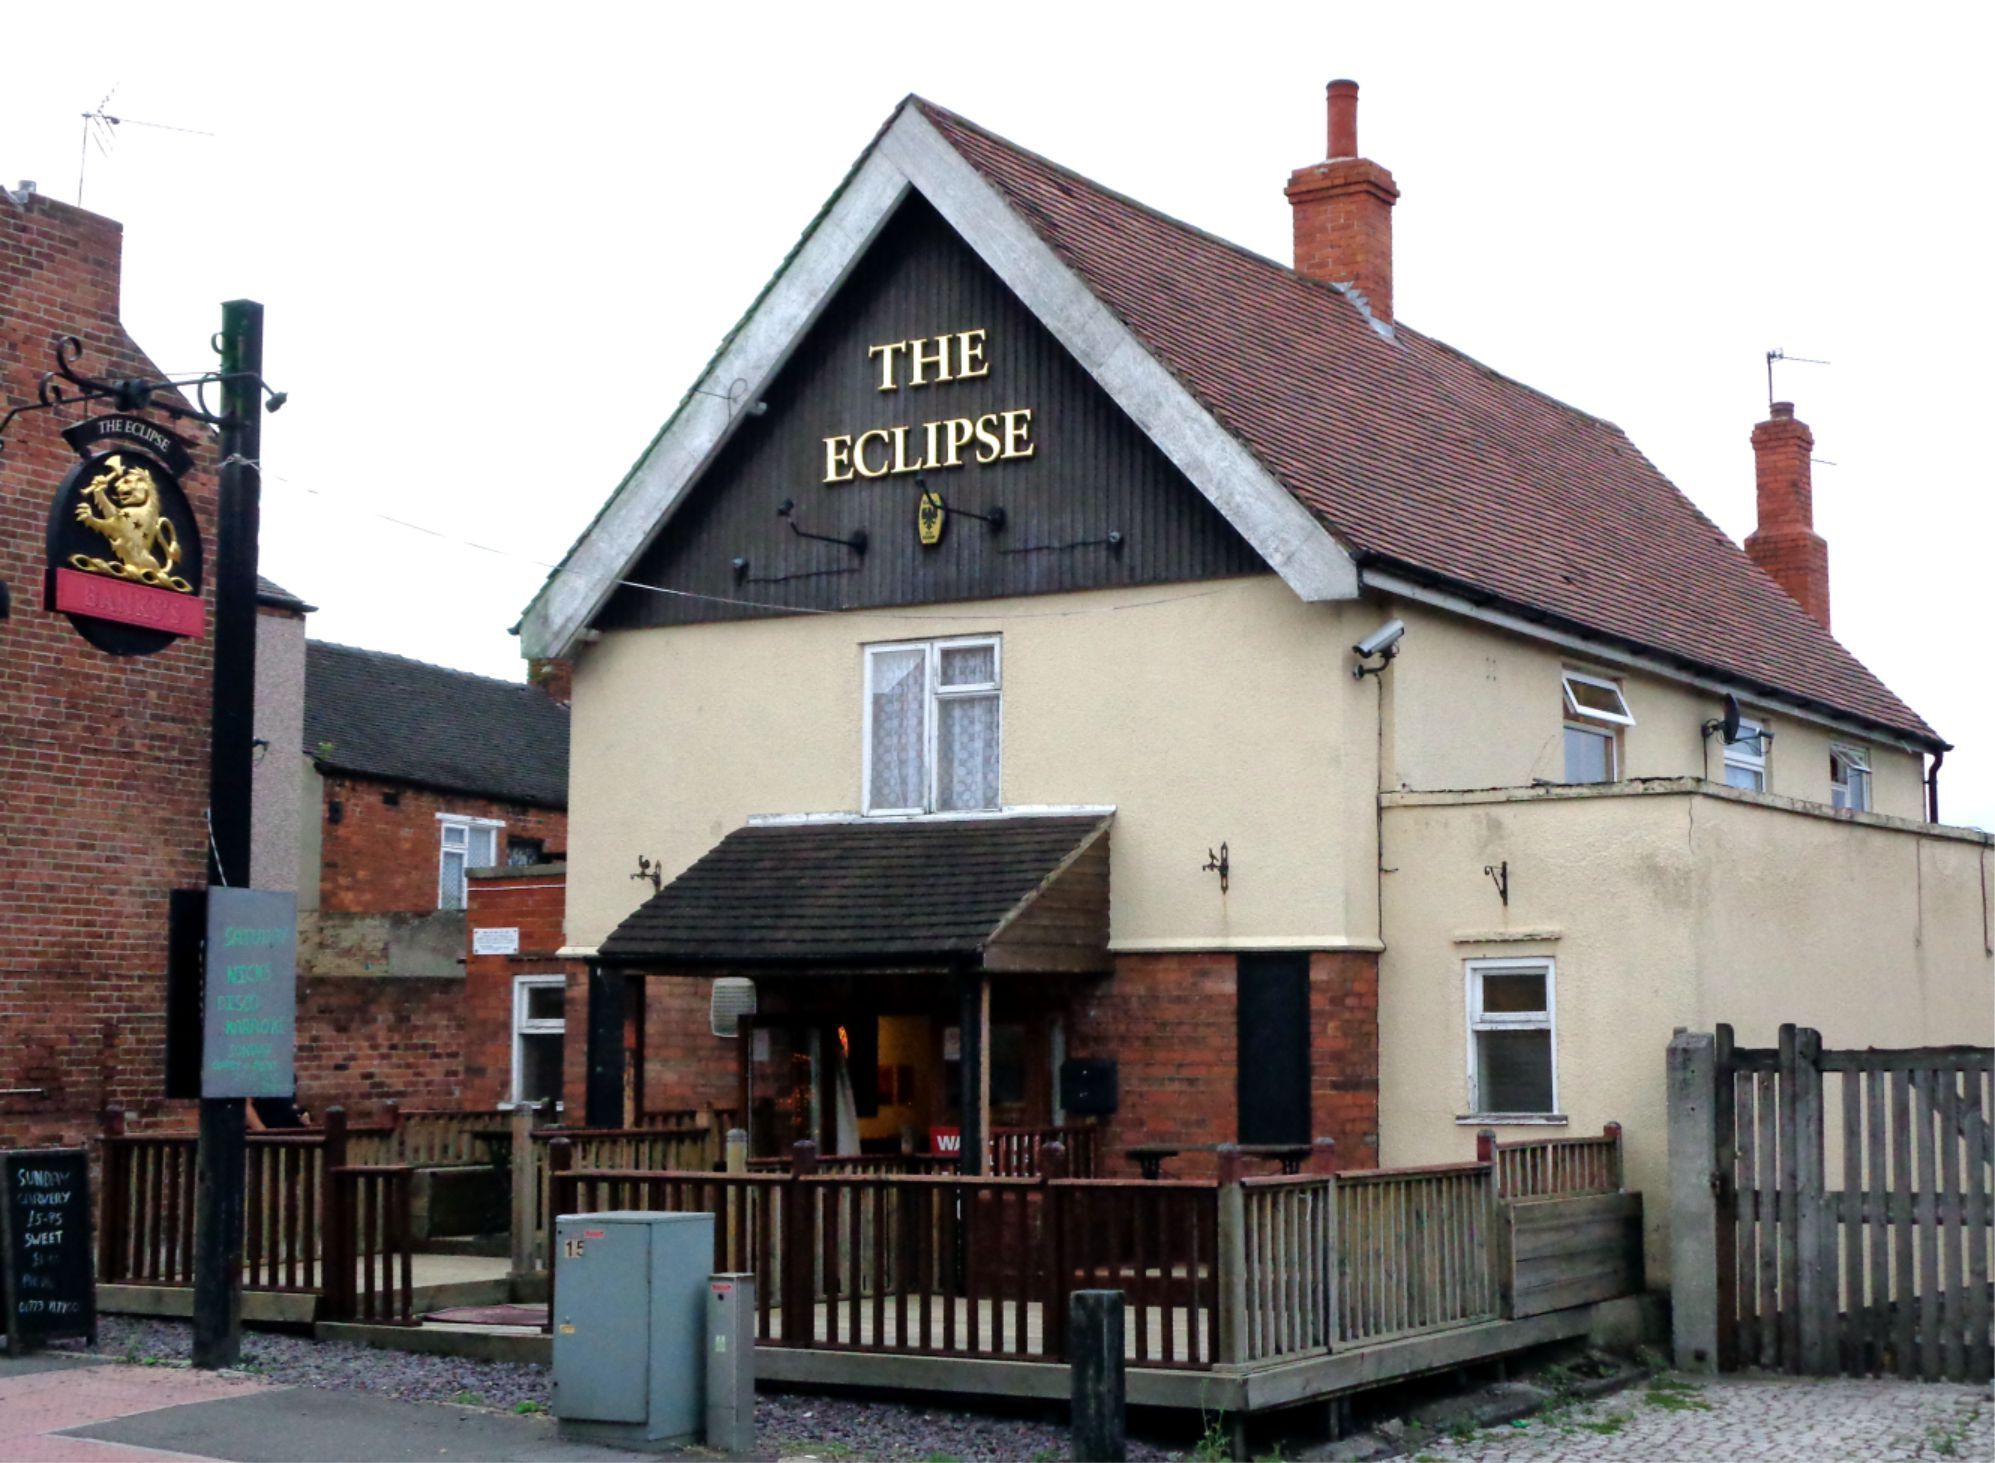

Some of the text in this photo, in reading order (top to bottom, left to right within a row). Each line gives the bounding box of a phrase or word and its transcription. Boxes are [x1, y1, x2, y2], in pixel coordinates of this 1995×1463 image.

[868, 328, 989, 390] THE
[98, 420, 171, 452] THE ECLIPSE
[822, 409, 1035, 483] ECLIPSE
[17, 1168, 71, 1187] SUNDAY
[24, 1230, 64, 1248] SWEET
[566, 1240, 585, 1257] 15
